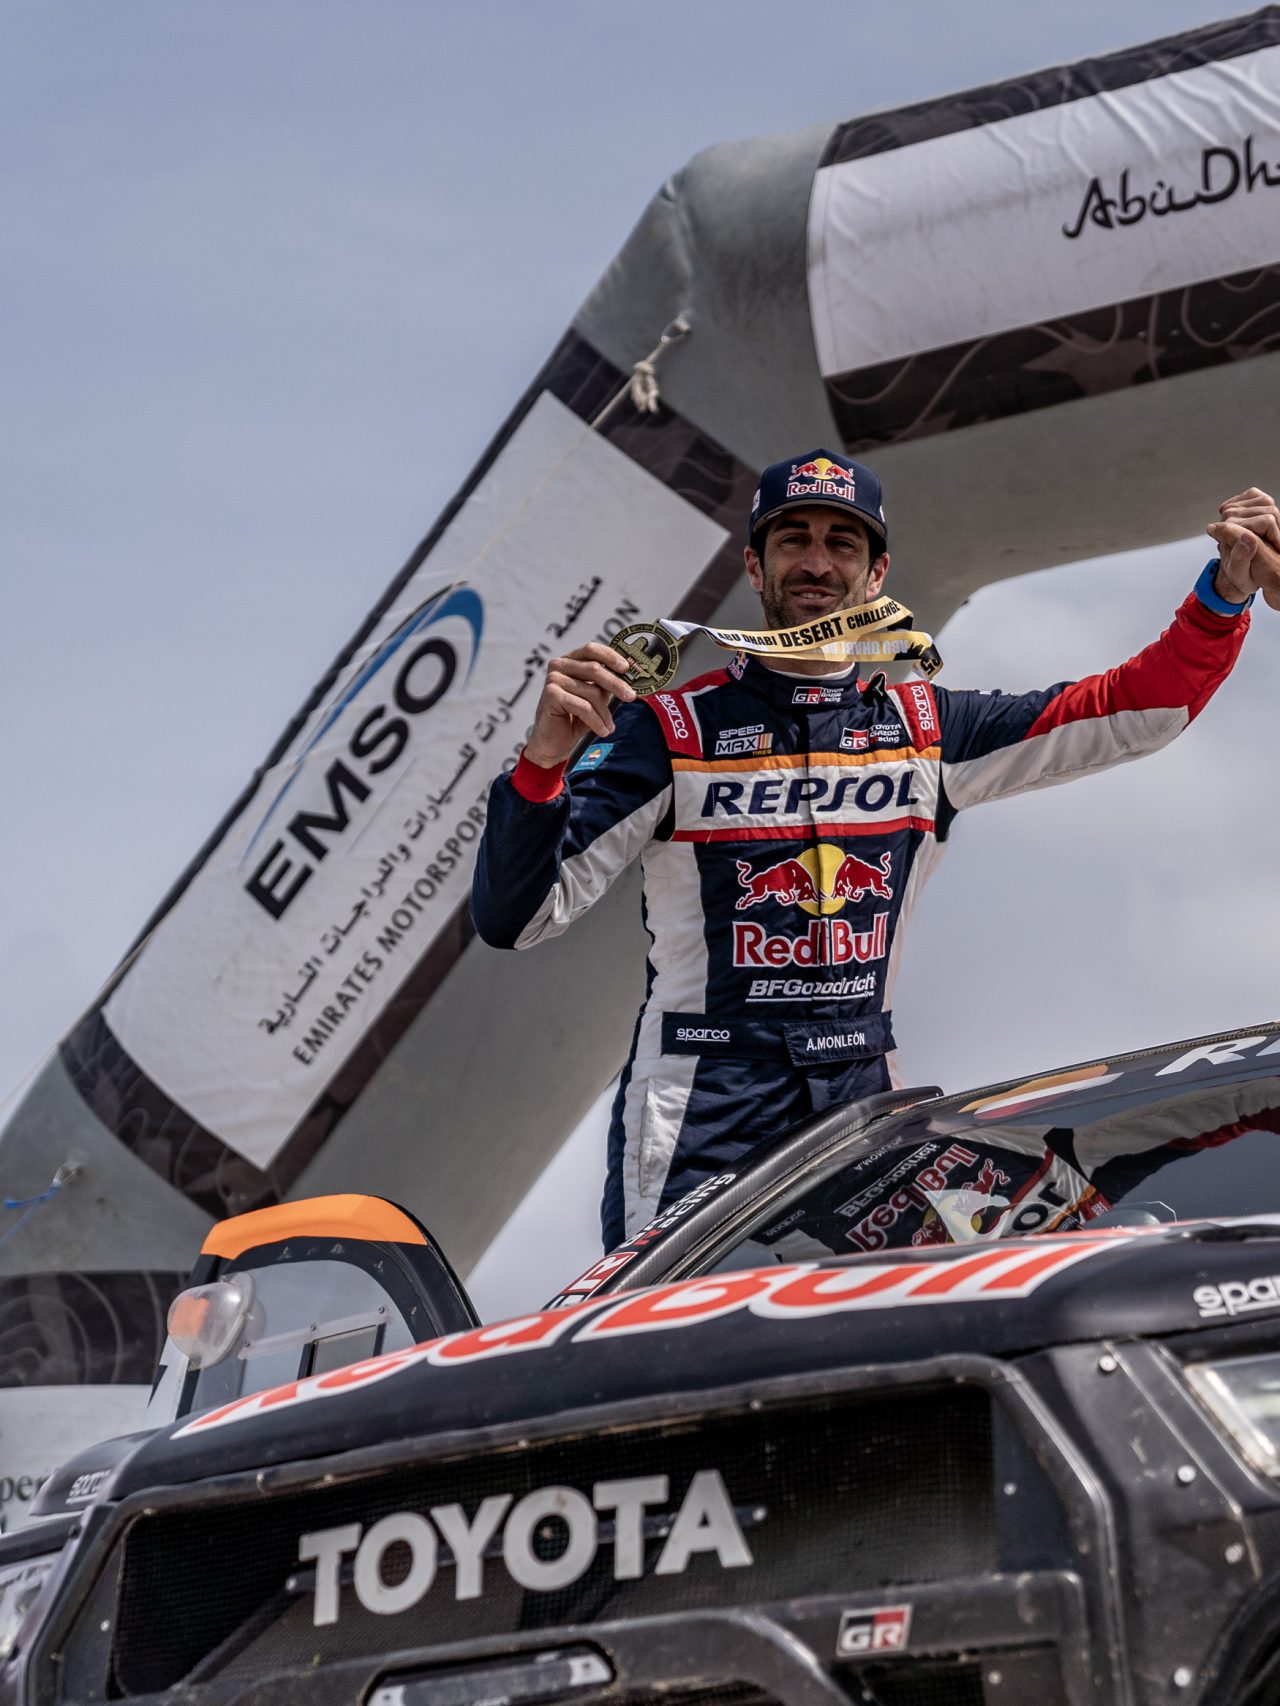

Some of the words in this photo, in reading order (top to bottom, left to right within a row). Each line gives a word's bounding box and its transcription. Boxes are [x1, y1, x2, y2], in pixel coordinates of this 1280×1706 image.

[1062, 167, 1200, 239] Abu
[787, 480, 821, 497] Red
[822, 481, 855, 501] Bull
[718, 632, 741, 642] ABU
[743, 634, 777, 646] DHABI
[779, 617, 844, 647] DESERT
[847, 601, 901, 629] CHALLENGE
[656, 692, 688, 740] sparco
[795, 693, 819, 703] GR
[911, 684, 935, 731] sparco
[716, 736, 758, 754] MAX
[719, 724, 764, 739] SPEED
[841, 736, 868, 748] GR
[869, 724, 902, 732] TOYOTA
[244, 635, 457, 921] EMSO
[701, 770, 920, 817] REPSOL
[292, 952, 384, 1066] EMIRATES
[380, 775, 497, 947] MOTORSPORT
[732, 917, 828, 968] Red
[830, 911, 890, 965] Bull
[748, 970, 876, 997] BFGoodrich
[676, 1027, 730, 1041] sparco
[806, 1032, 866, 1051] A.MONLEÓN
[572, 1233, 1130, 1342] Bull
[299, 1469, 754, 1626] TOYOTA
[841, 1619, 906, 1651] GR
